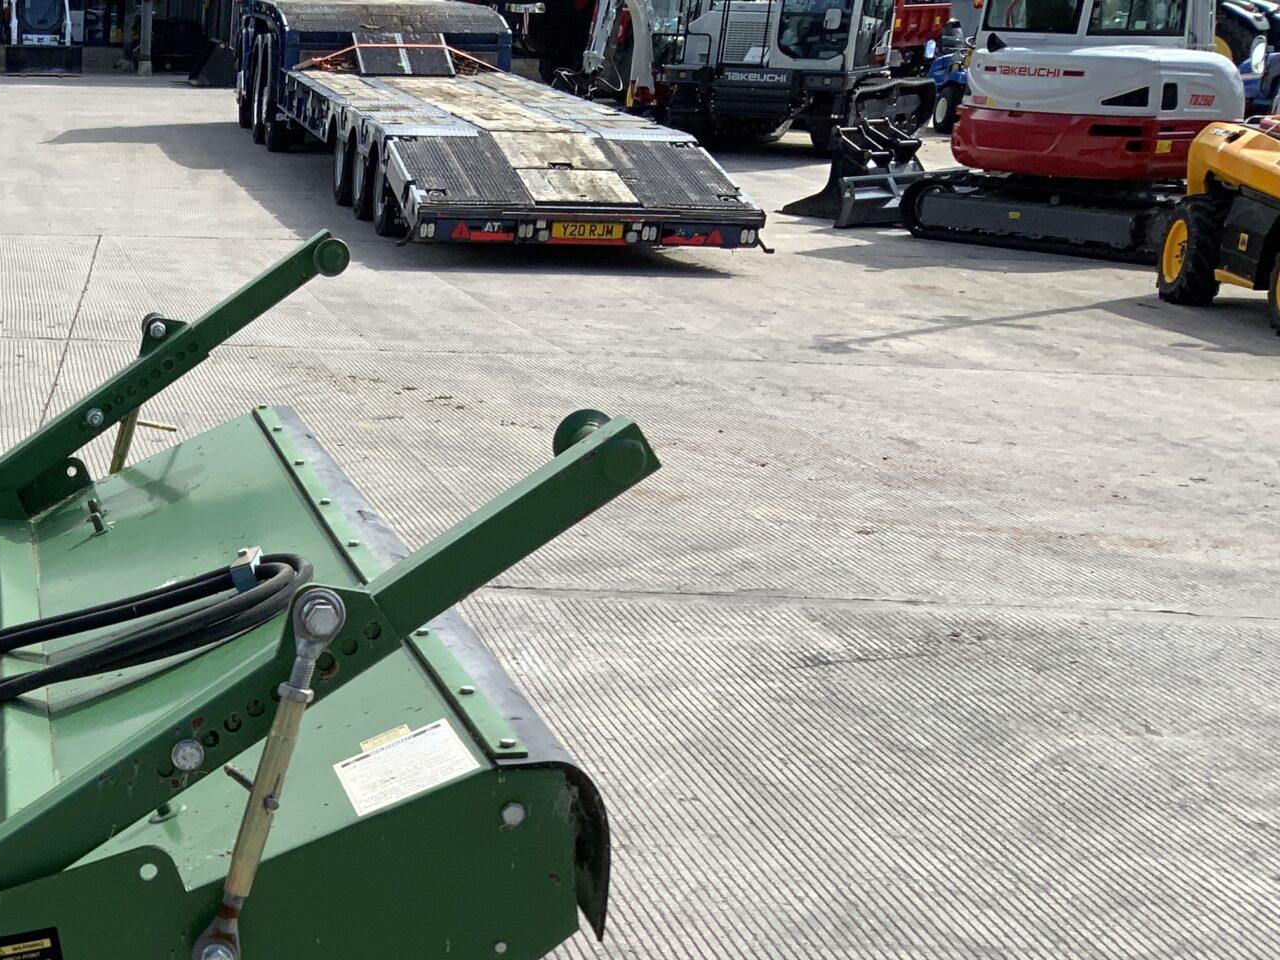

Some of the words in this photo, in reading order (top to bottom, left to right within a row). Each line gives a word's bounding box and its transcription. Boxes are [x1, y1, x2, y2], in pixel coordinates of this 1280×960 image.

[724, 71, 787, 83] TAKEUCHI
[999, 65, 1061, 78] TAKEUCHI
[1189, 94, 1216, 107] TB260
[483, 221, 502, 233] AT
[562, 224, 586, 237] Y20
[589, 224, 614, 237] RJM
